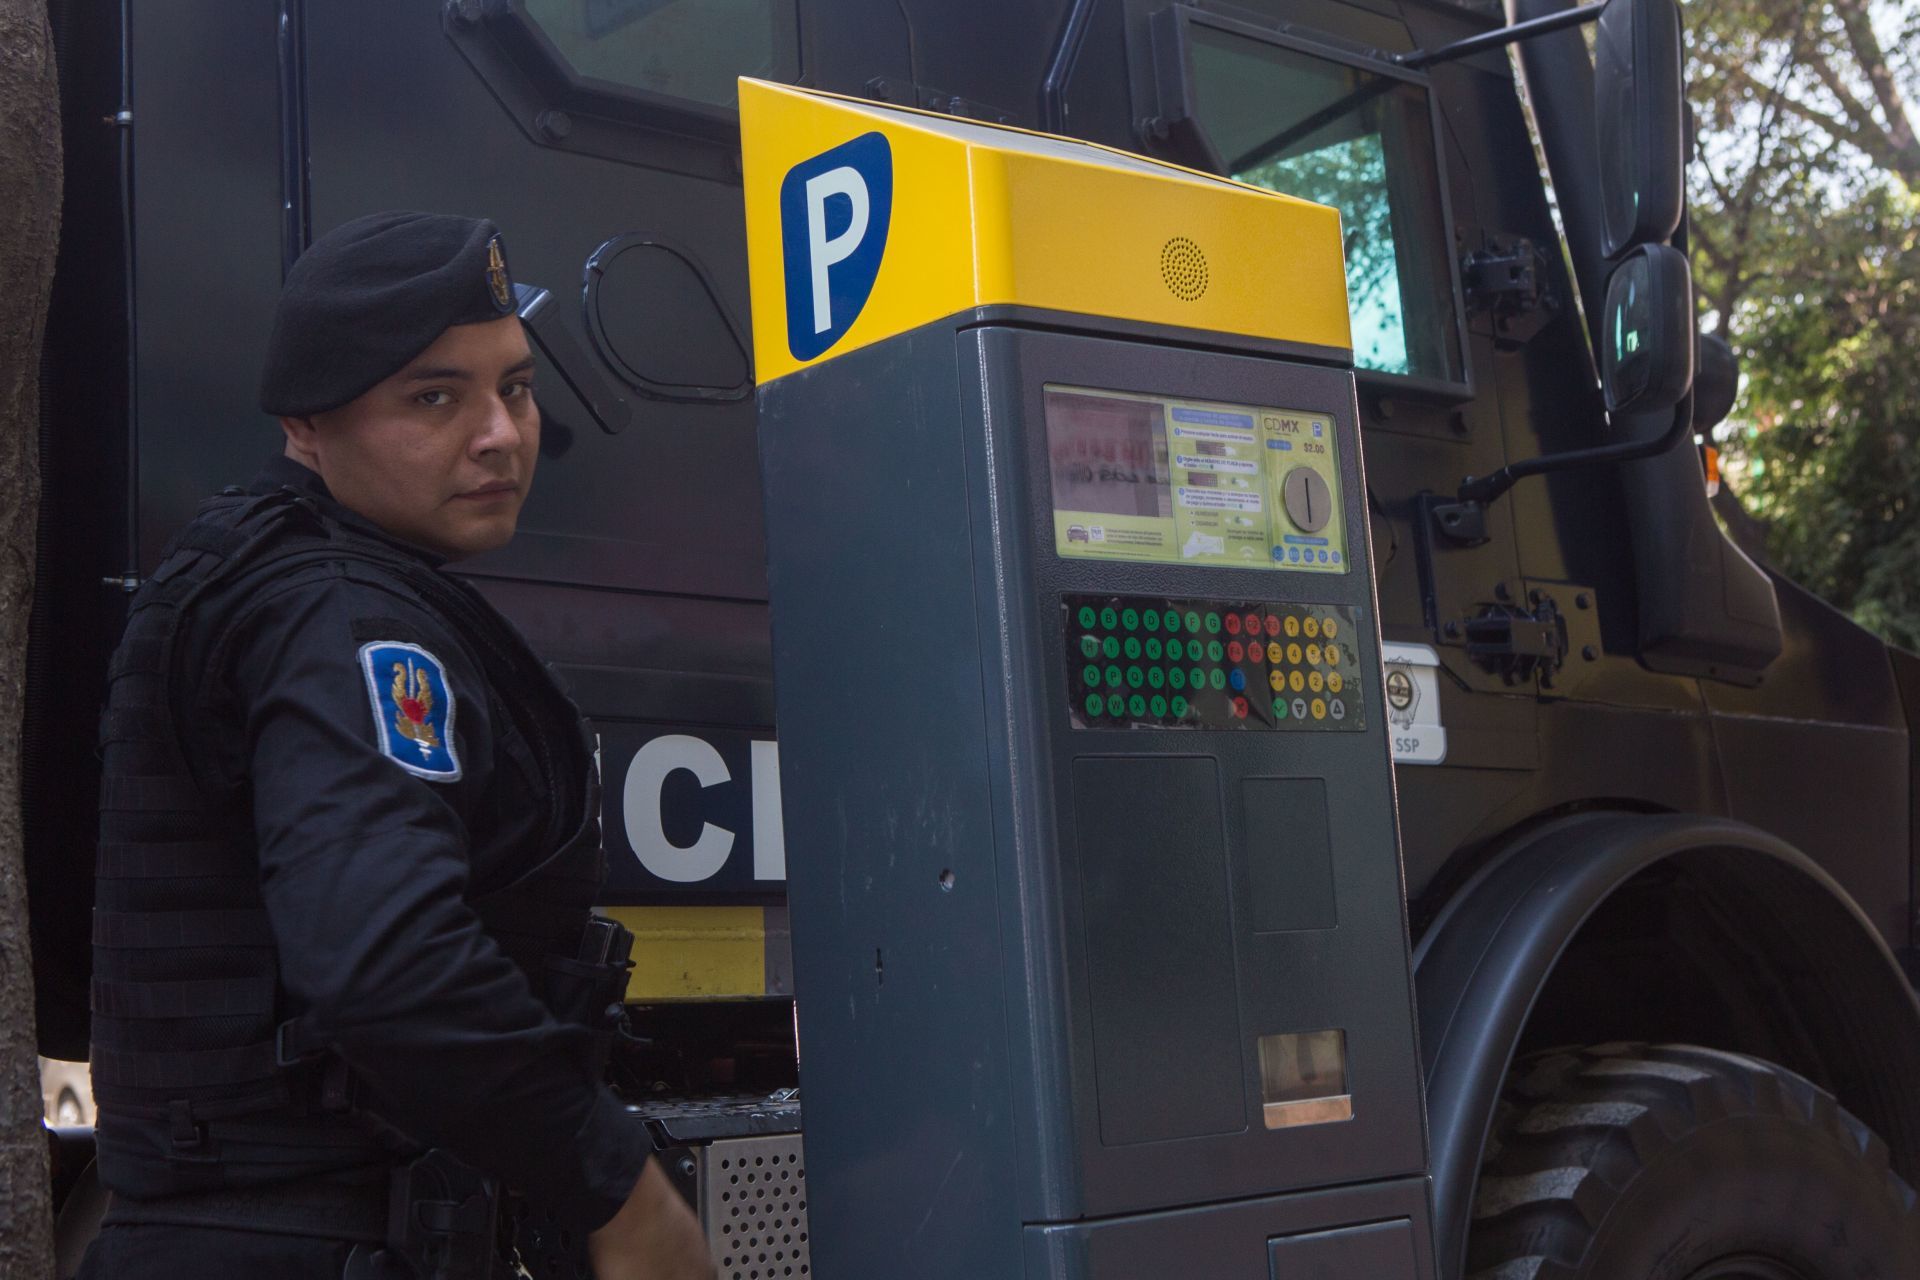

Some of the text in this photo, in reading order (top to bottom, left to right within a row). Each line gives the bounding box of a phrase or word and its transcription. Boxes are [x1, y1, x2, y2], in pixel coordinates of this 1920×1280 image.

[806, 166, 870, 334] P
[1263, 417, 1300, 433] CDMX
[1303, 442, 1325, 454] $2.00
[1395, 737, 1420, 753] SSP
[594, 733, 787, 883] CI
